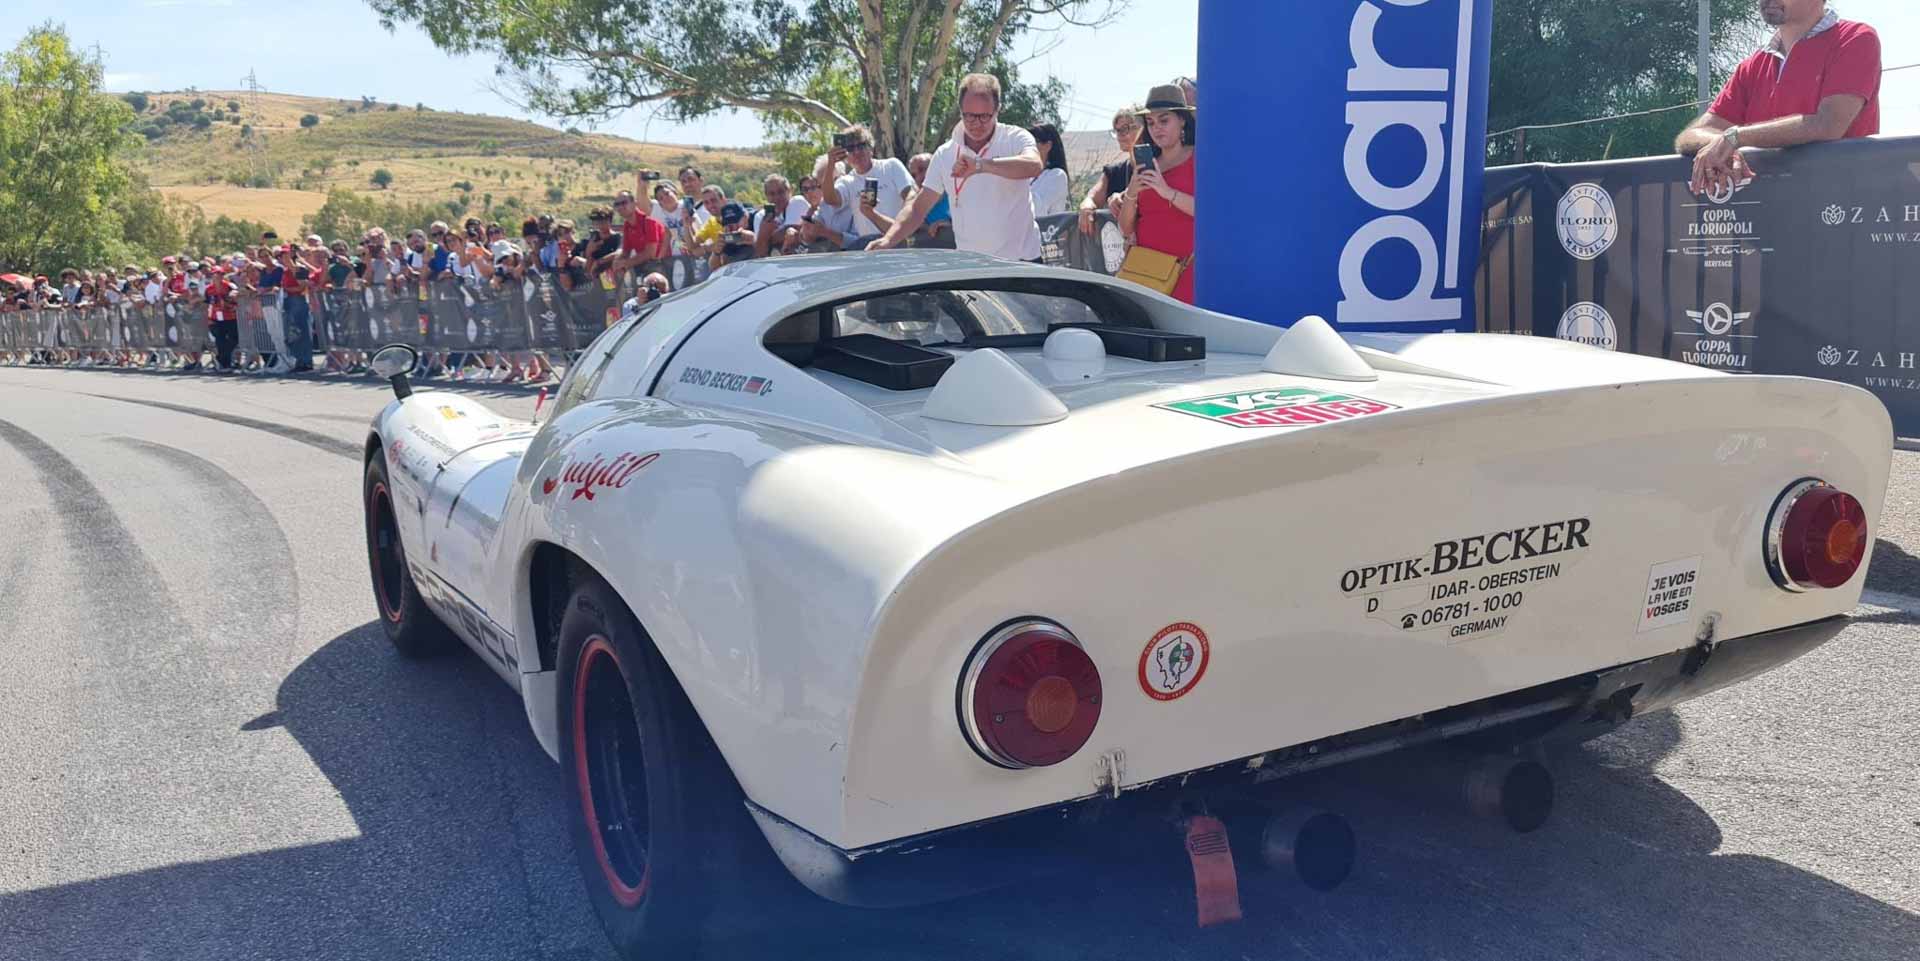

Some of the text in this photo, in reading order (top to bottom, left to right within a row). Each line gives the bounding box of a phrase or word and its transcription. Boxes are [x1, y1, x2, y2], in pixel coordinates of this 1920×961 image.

[1561, 217, 1613, 226] FLORIO
[1703, 209, 1737, 222] COPPA
[1688, 222, 1753, 236] FLORIOPOLI
[1695, 339, 1731, 353] COPPA
[1682, 351, 1747, 367] FLORIOPOLI
[679, 366, 713, 386] BERND
[708, 371, 748, 393] BECKER
[1651, 570, 1696, 591] JE VOIS
[1367, 597, 1379, 613] D
[1647, 593, 1661, 605] LA
[1662, 589, 1679, 601] VIE
[1646, 599, 1690, 619] VOSGES
[1451, 615, 1508, 637] GERMANY
